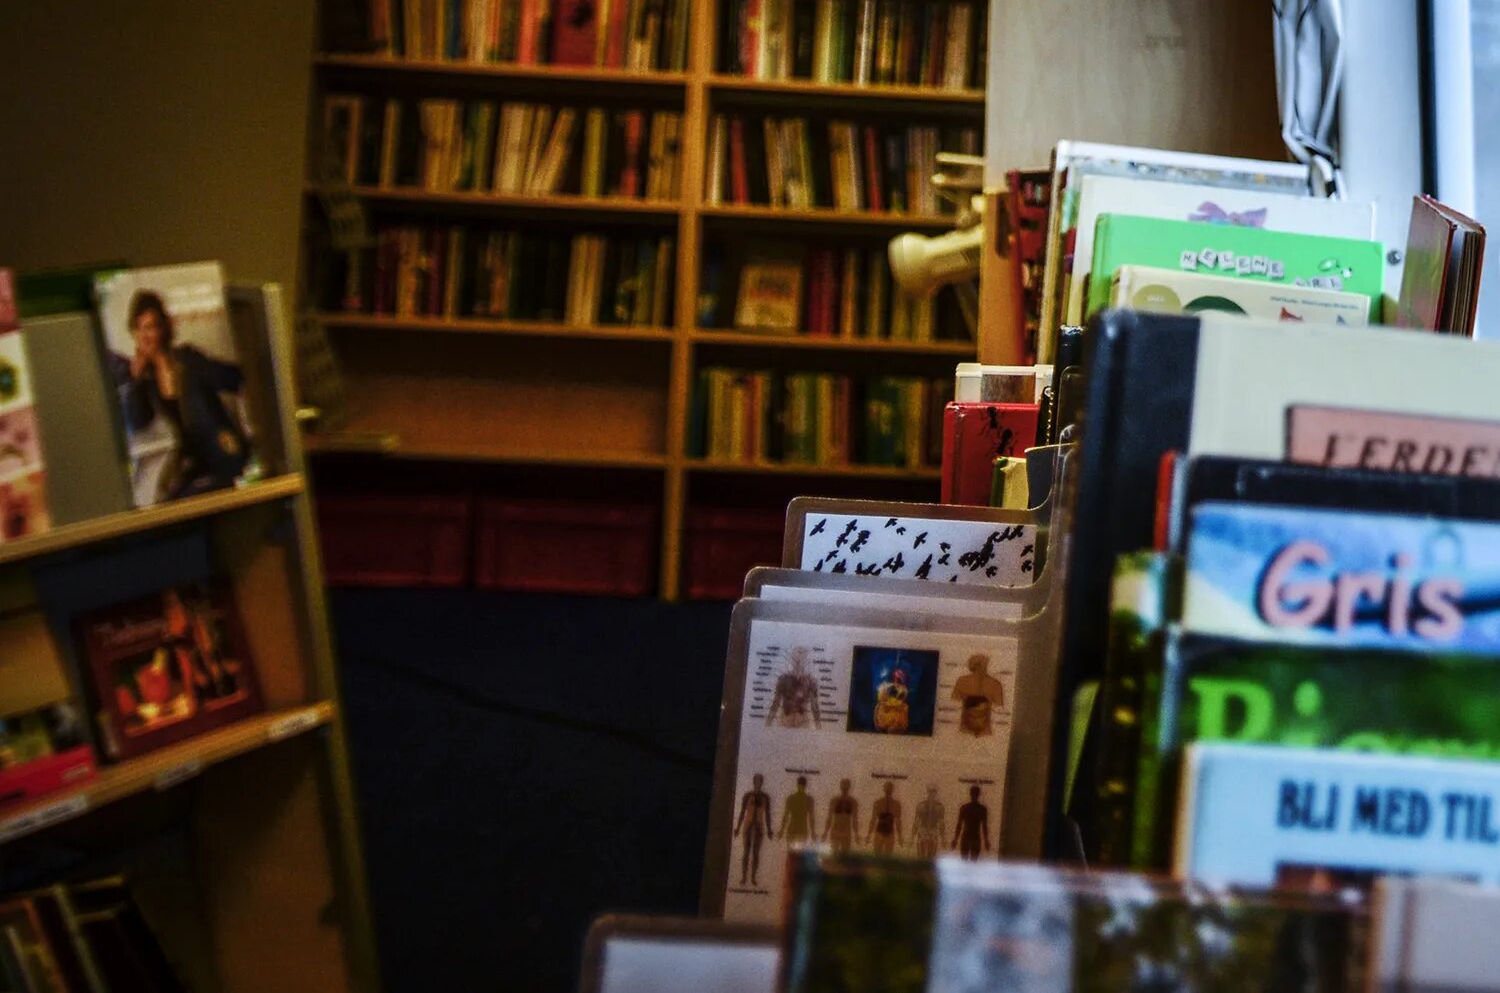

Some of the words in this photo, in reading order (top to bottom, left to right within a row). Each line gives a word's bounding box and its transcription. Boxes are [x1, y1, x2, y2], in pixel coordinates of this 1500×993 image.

[1182, 250, 1281, 275] HELENE
[1257, 538, 1464, 638] Gris
[1278, 779, 1339, 829] BLI
[1353, 785, 1431, 838] MED
[1443, 791, 1500, 843] TIL
